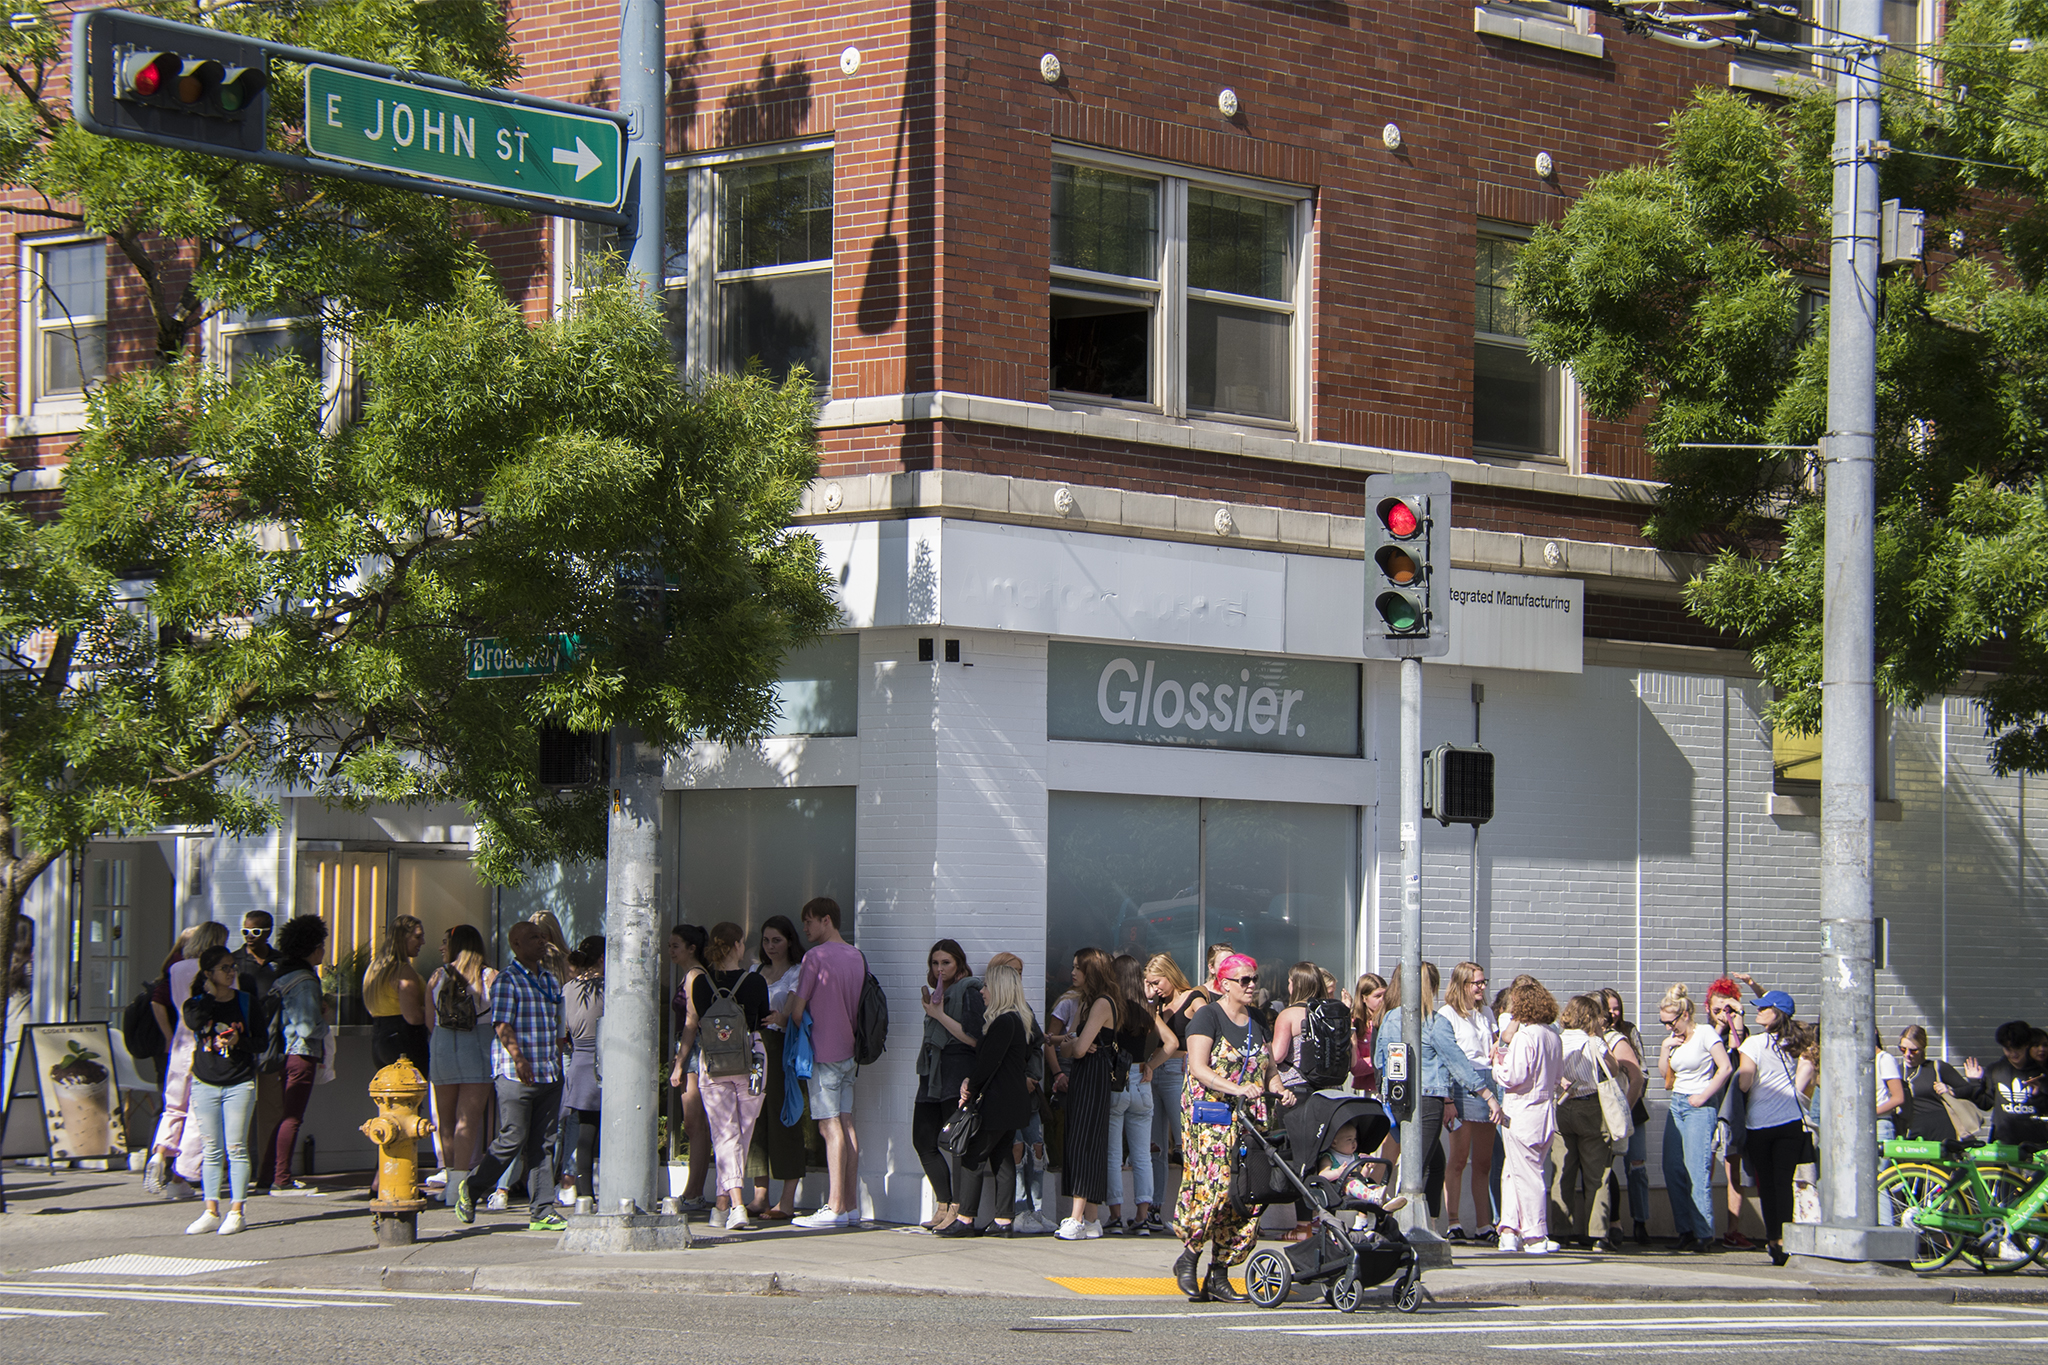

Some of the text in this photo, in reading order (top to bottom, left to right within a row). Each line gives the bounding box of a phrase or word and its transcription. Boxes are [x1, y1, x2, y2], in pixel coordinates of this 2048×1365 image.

[327, 93, 529, 162] E JOHN ST
[1449, 587, 1571, 613] tegrated Manufacturing
[1097, 658, 1305, 737] Glossier.
[2001, 1102, 2036, 1114] ddas
